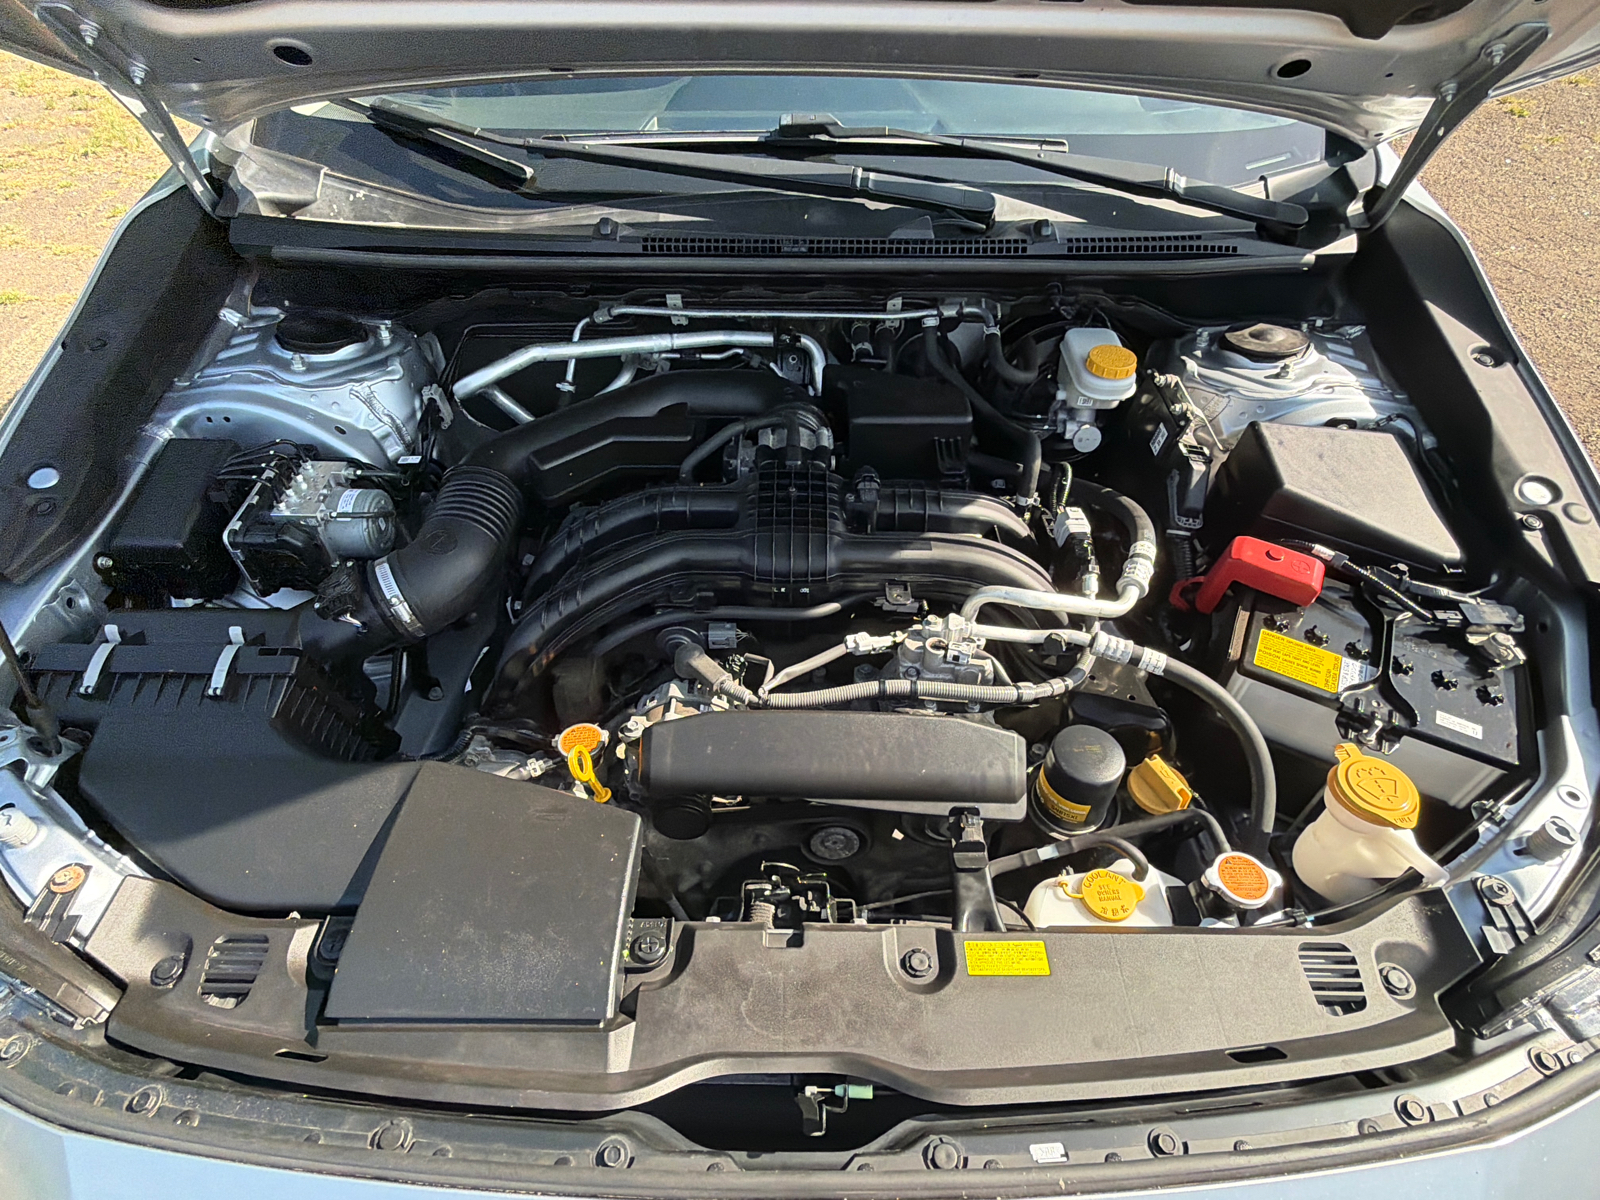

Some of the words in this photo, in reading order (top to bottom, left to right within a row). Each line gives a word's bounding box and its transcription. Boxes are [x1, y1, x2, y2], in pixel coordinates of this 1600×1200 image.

[1262, 630, 1285, 642] DANGER
[1258, 648, 1280, 660] POISON
[1083, 871, 1126, 888] COOLANT
